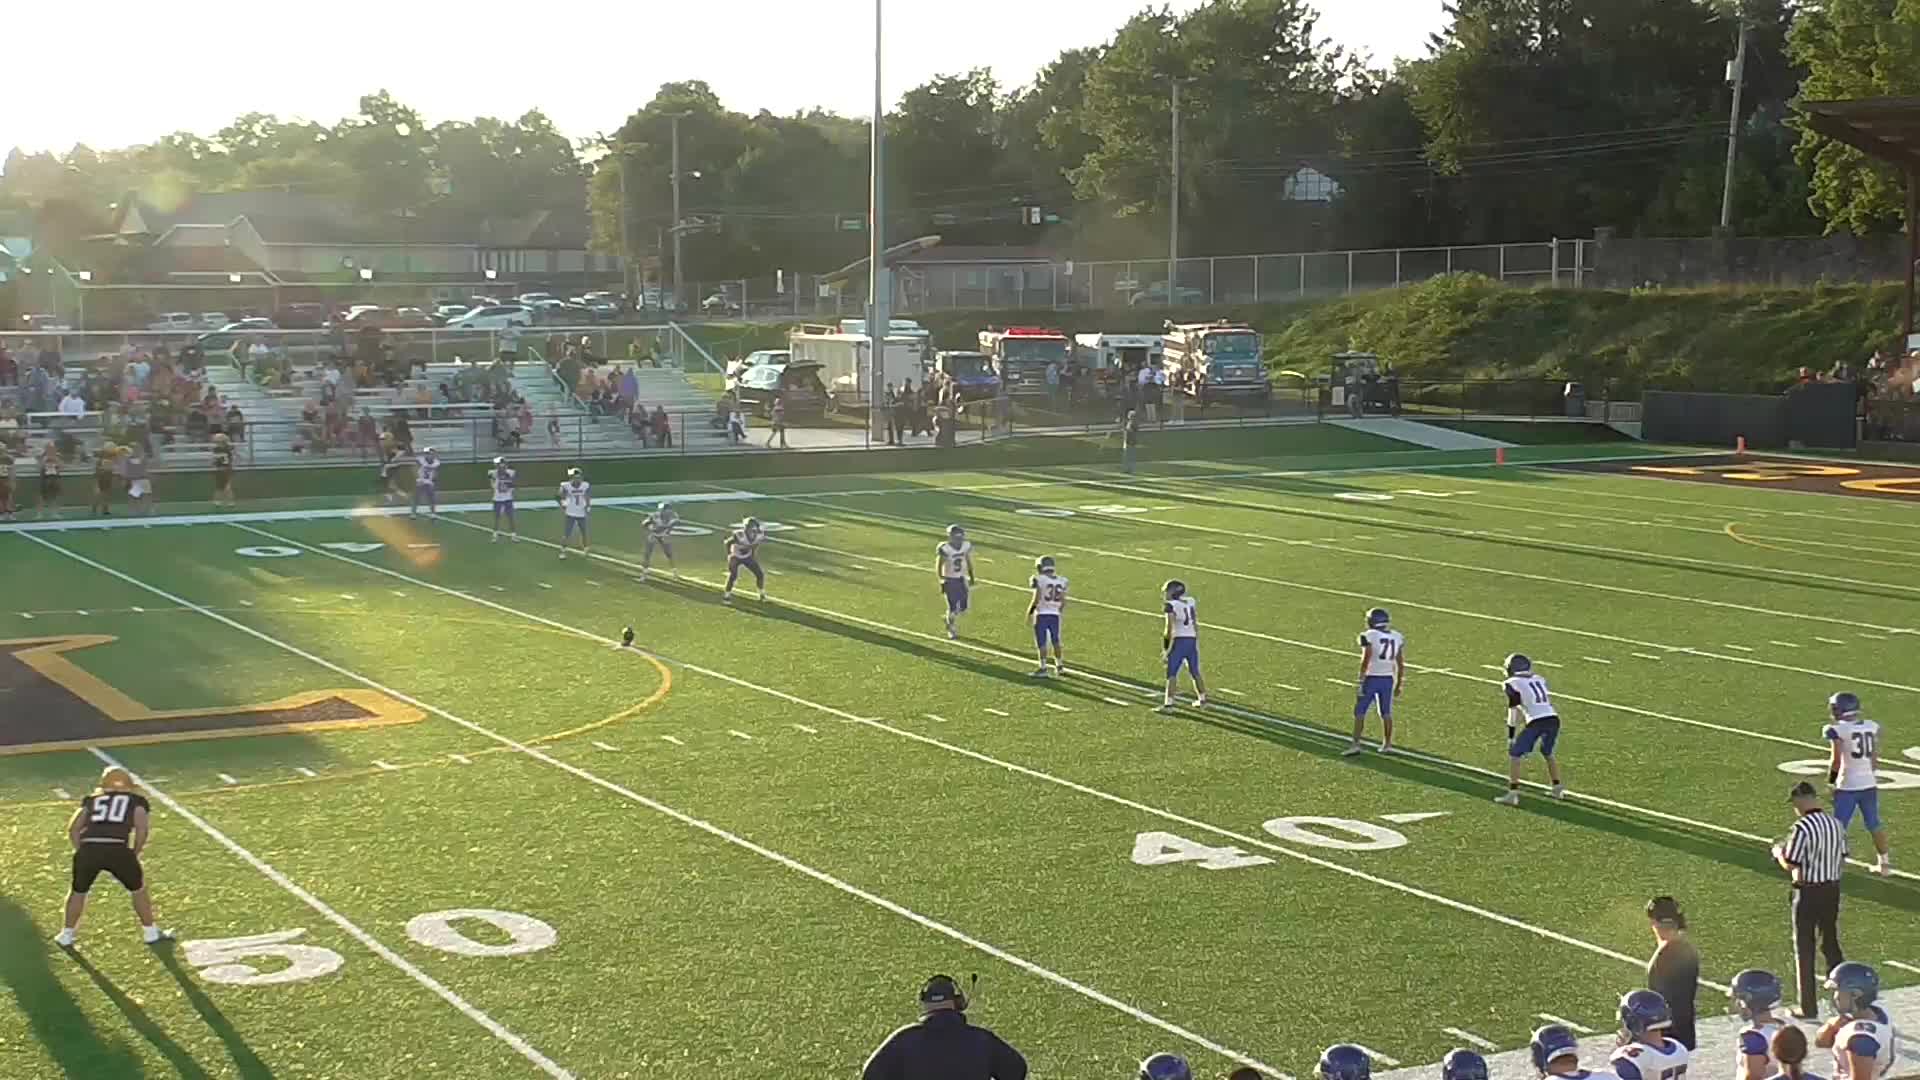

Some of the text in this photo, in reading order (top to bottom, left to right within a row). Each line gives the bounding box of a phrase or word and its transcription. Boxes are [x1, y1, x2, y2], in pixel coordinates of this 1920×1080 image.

[1044, 583, 1064, 602] 36
[1378, 637, 1396, 661] 71
[1528, 680, 1548, 704] 11
[1850, 731, 1875, 759] 30
[91, 794, 130, 823] 50
[178, 907, 557, 986] 50
